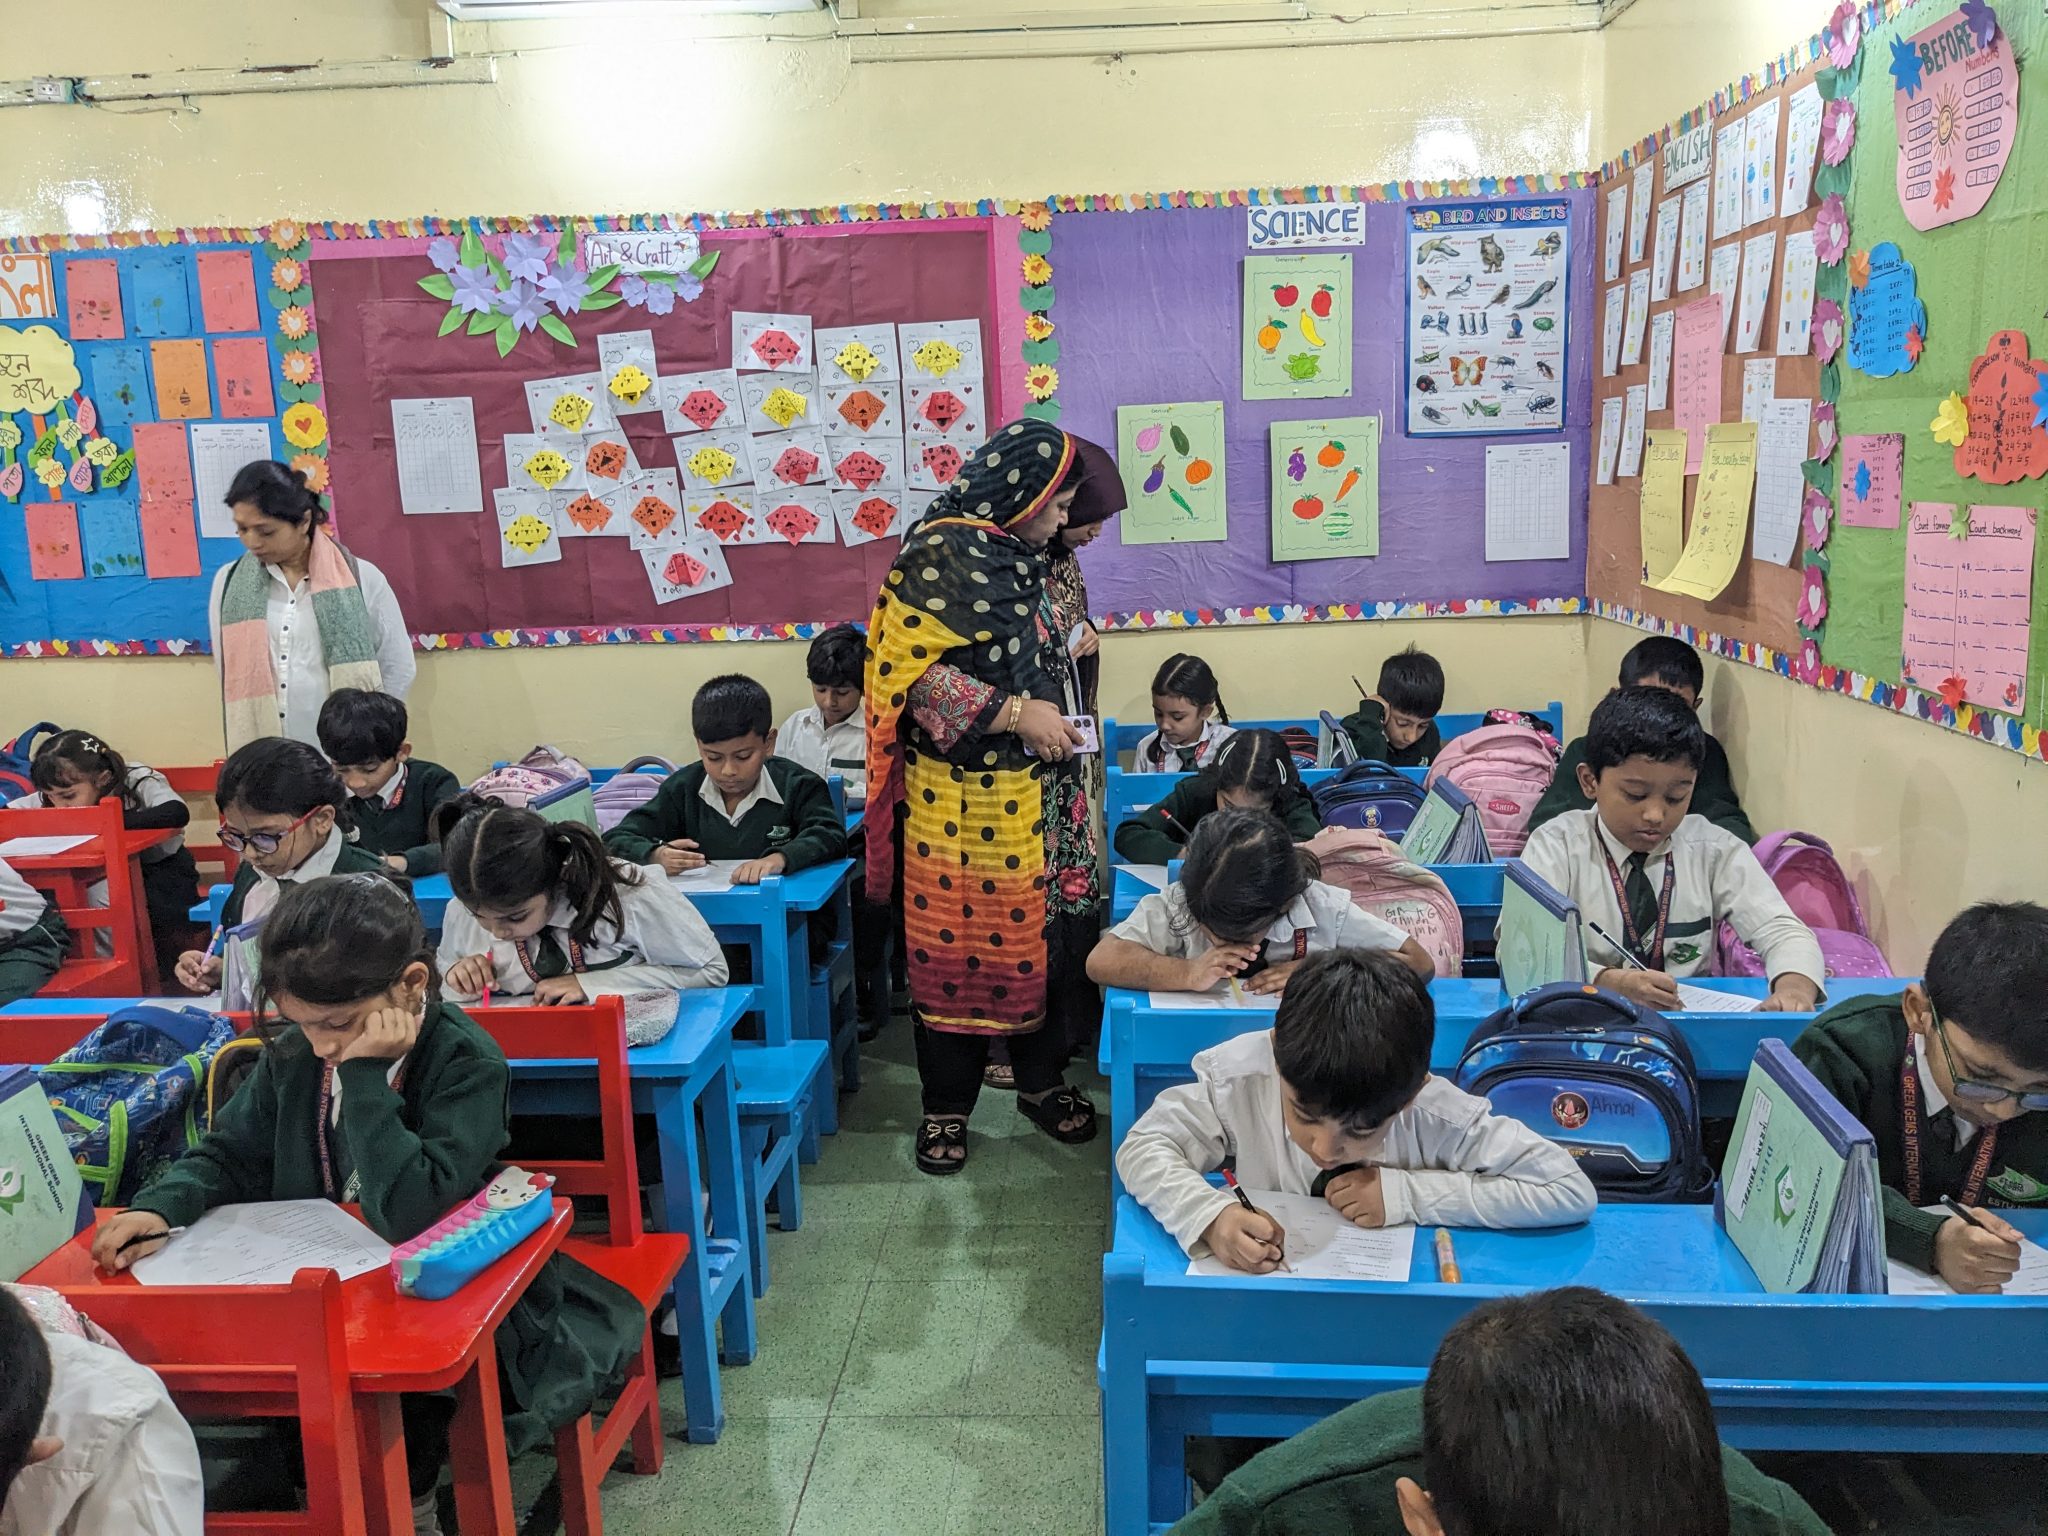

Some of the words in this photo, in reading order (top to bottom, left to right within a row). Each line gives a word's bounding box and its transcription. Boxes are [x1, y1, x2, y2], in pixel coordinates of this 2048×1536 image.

[1919, 21, 1976, 76] BEFORE
[1965, 46, 2000, 73] Numbers
[1664, 124, 1713, 182] ENGLISH
[1251, 207, 1360, 244] SCIENCE
[1442, 209, 1474, 225] BIRD
[1476, 208, 1507, 223] AND
[1510, 206, 1567, 221] INSECTS
[590, 241, 615, 267] Art
[620, 241, 633, 264] &
[636, 240, 673, 266] Craft
[0, 354, 30, 378] তুন
[1971, 351, 2000, 388] COMPARISON
[2013, 357, 2038, 378] NUMBERS
[1914, 515, 1929, 531] Count
[1968, 520, 1987, 534] Count
[1495, 803, 1514, 812] SHEEP
[1903, 1075, 1916, 1111] GREEN
[1904, 1110, 1917, 1136] GEMS
[18, 1114, 50, 1182] INTERNATIONAL
[47, 1180, 64, 1214] SCHOOL
[35, 1134, 51, 1163] GREEN
[48, 1162, 61, 1187] GEMS
[1757, 1145, 1774, 1193] Diary
[1798, 1166, 1823, 1244] INTERNATIONAL
[1807, 1200, 1819, 1236] GREEN
[1785, 1247, 1800, 1287] SCHOOL
[1797, 1236, 1809, 1266] GEMS
